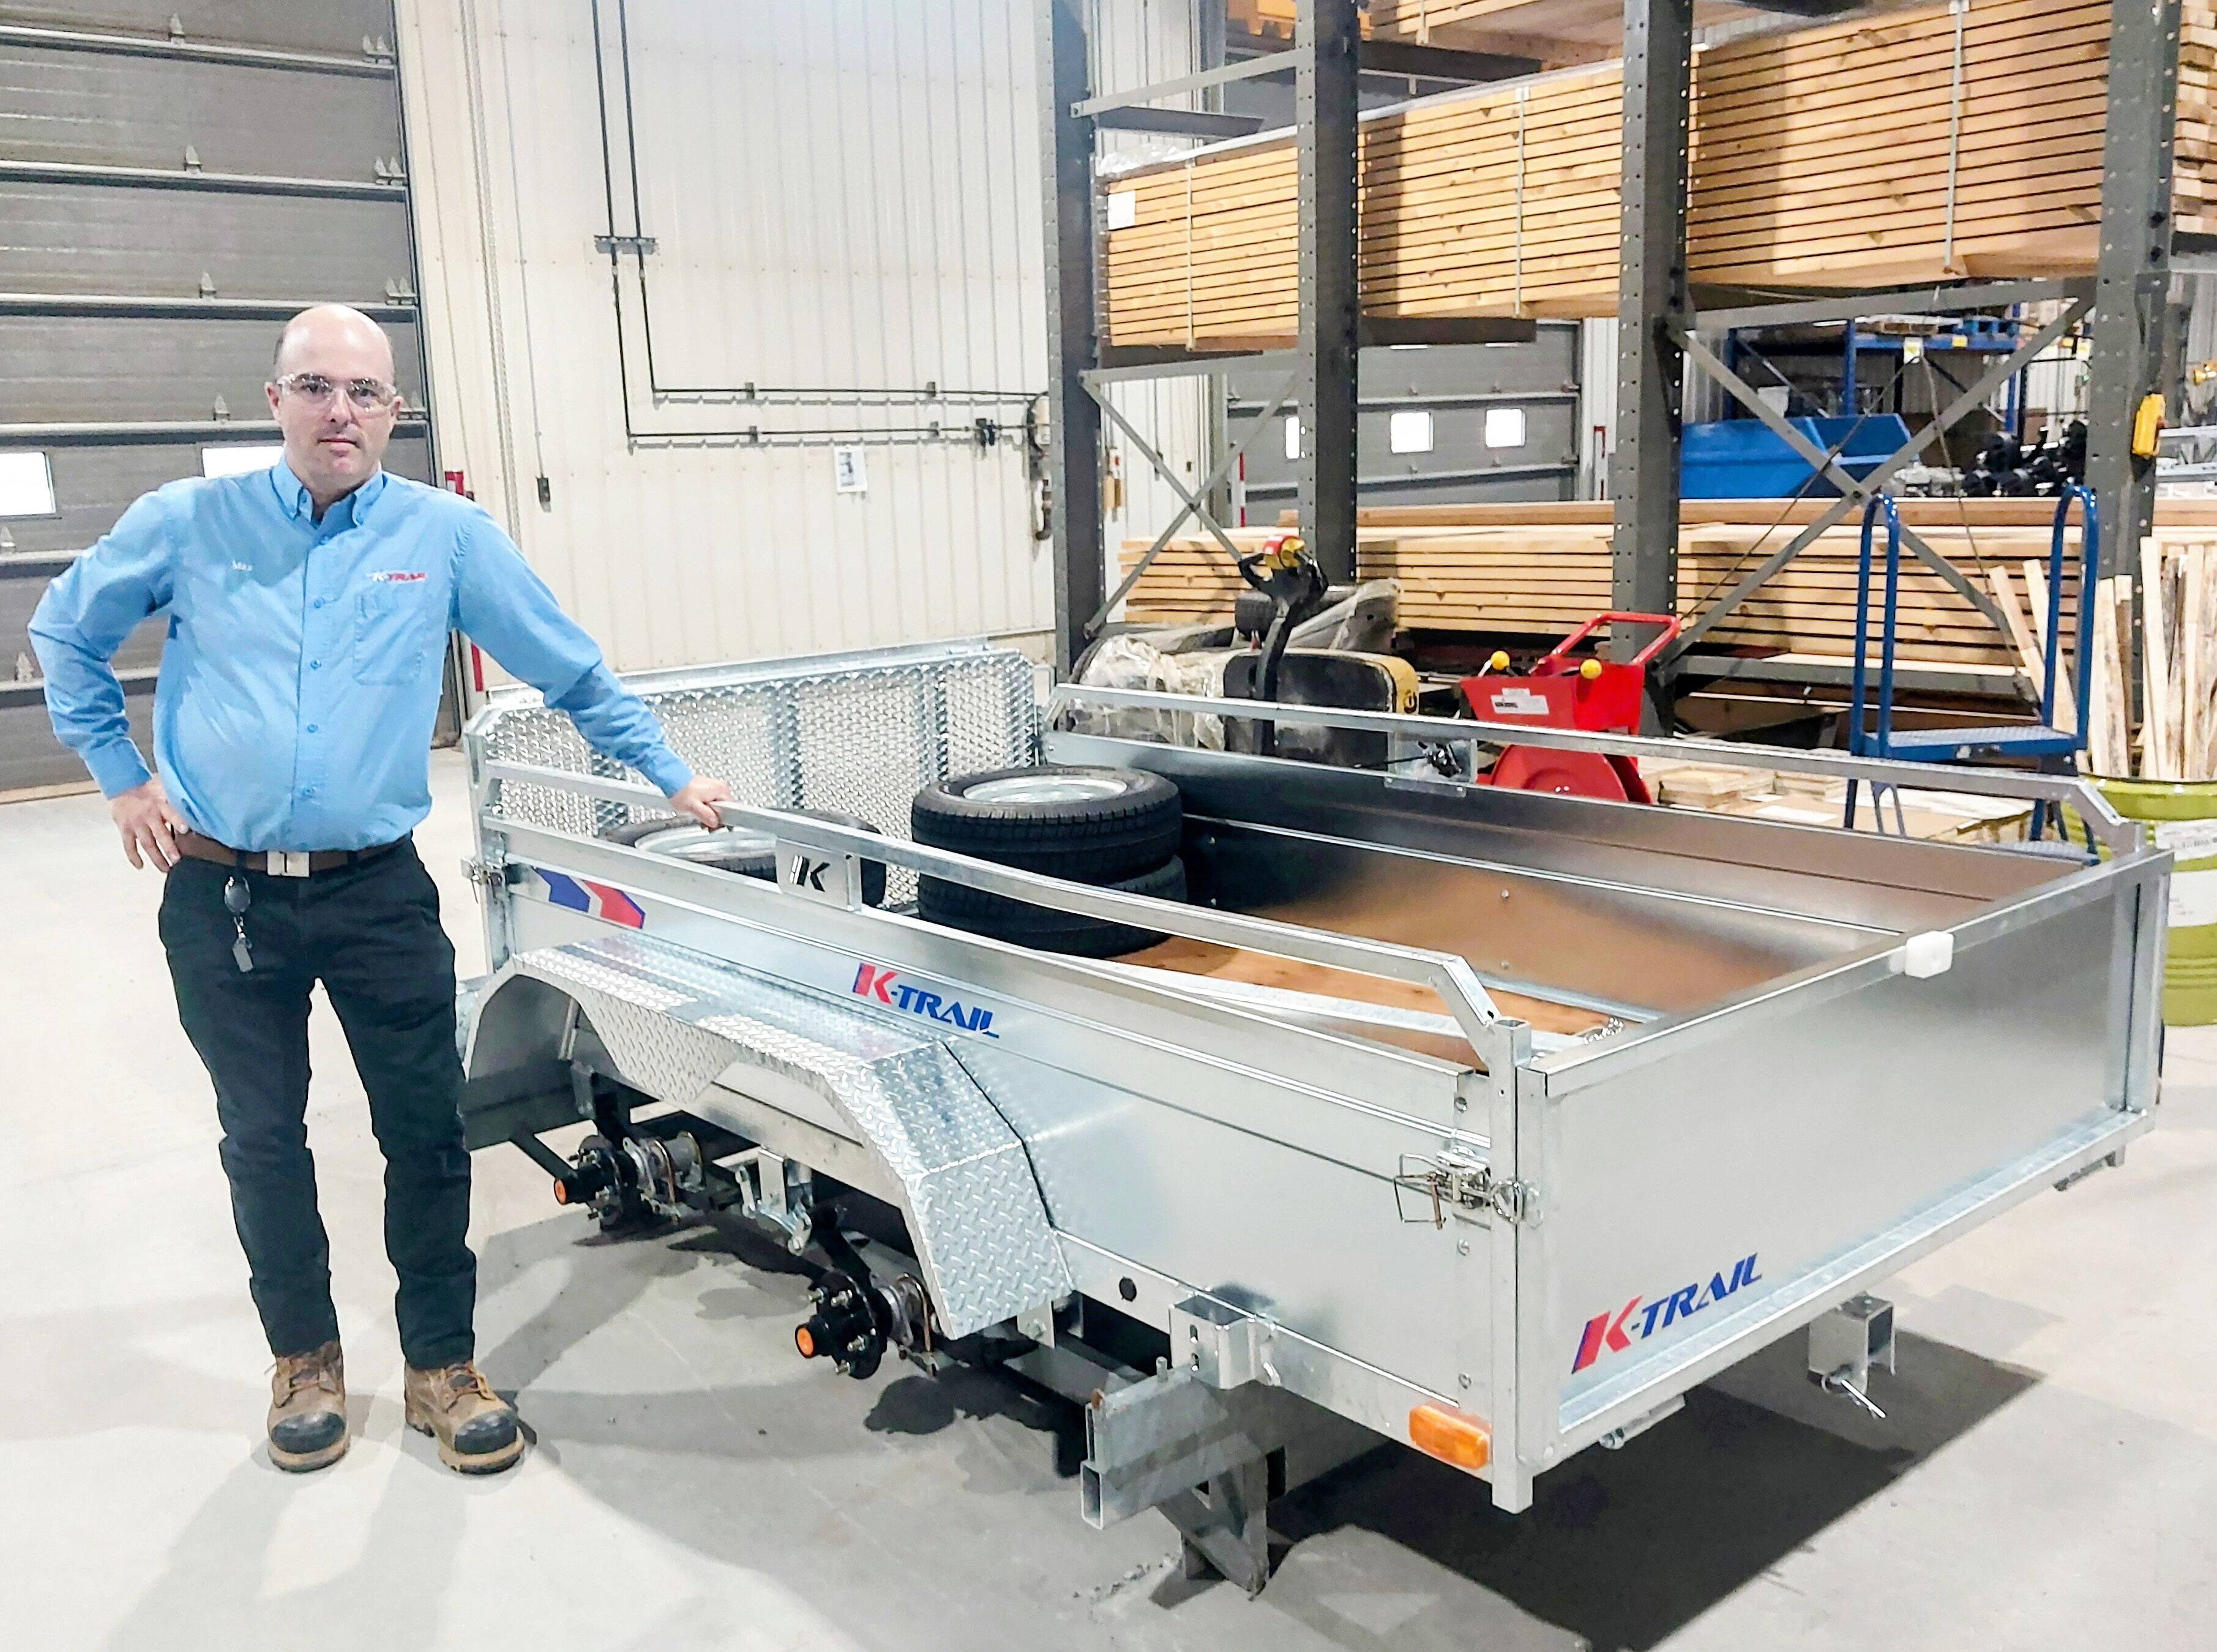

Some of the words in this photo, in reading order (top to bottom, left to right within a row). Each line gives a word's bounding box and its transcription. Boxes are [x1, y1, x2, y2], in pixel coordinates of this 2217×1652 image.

[790, 855, 830, 892] K
[852, 963, 1000, 1039] K-TRAIL
[1572, 1253, 1763, 1374] K-TRAIL
